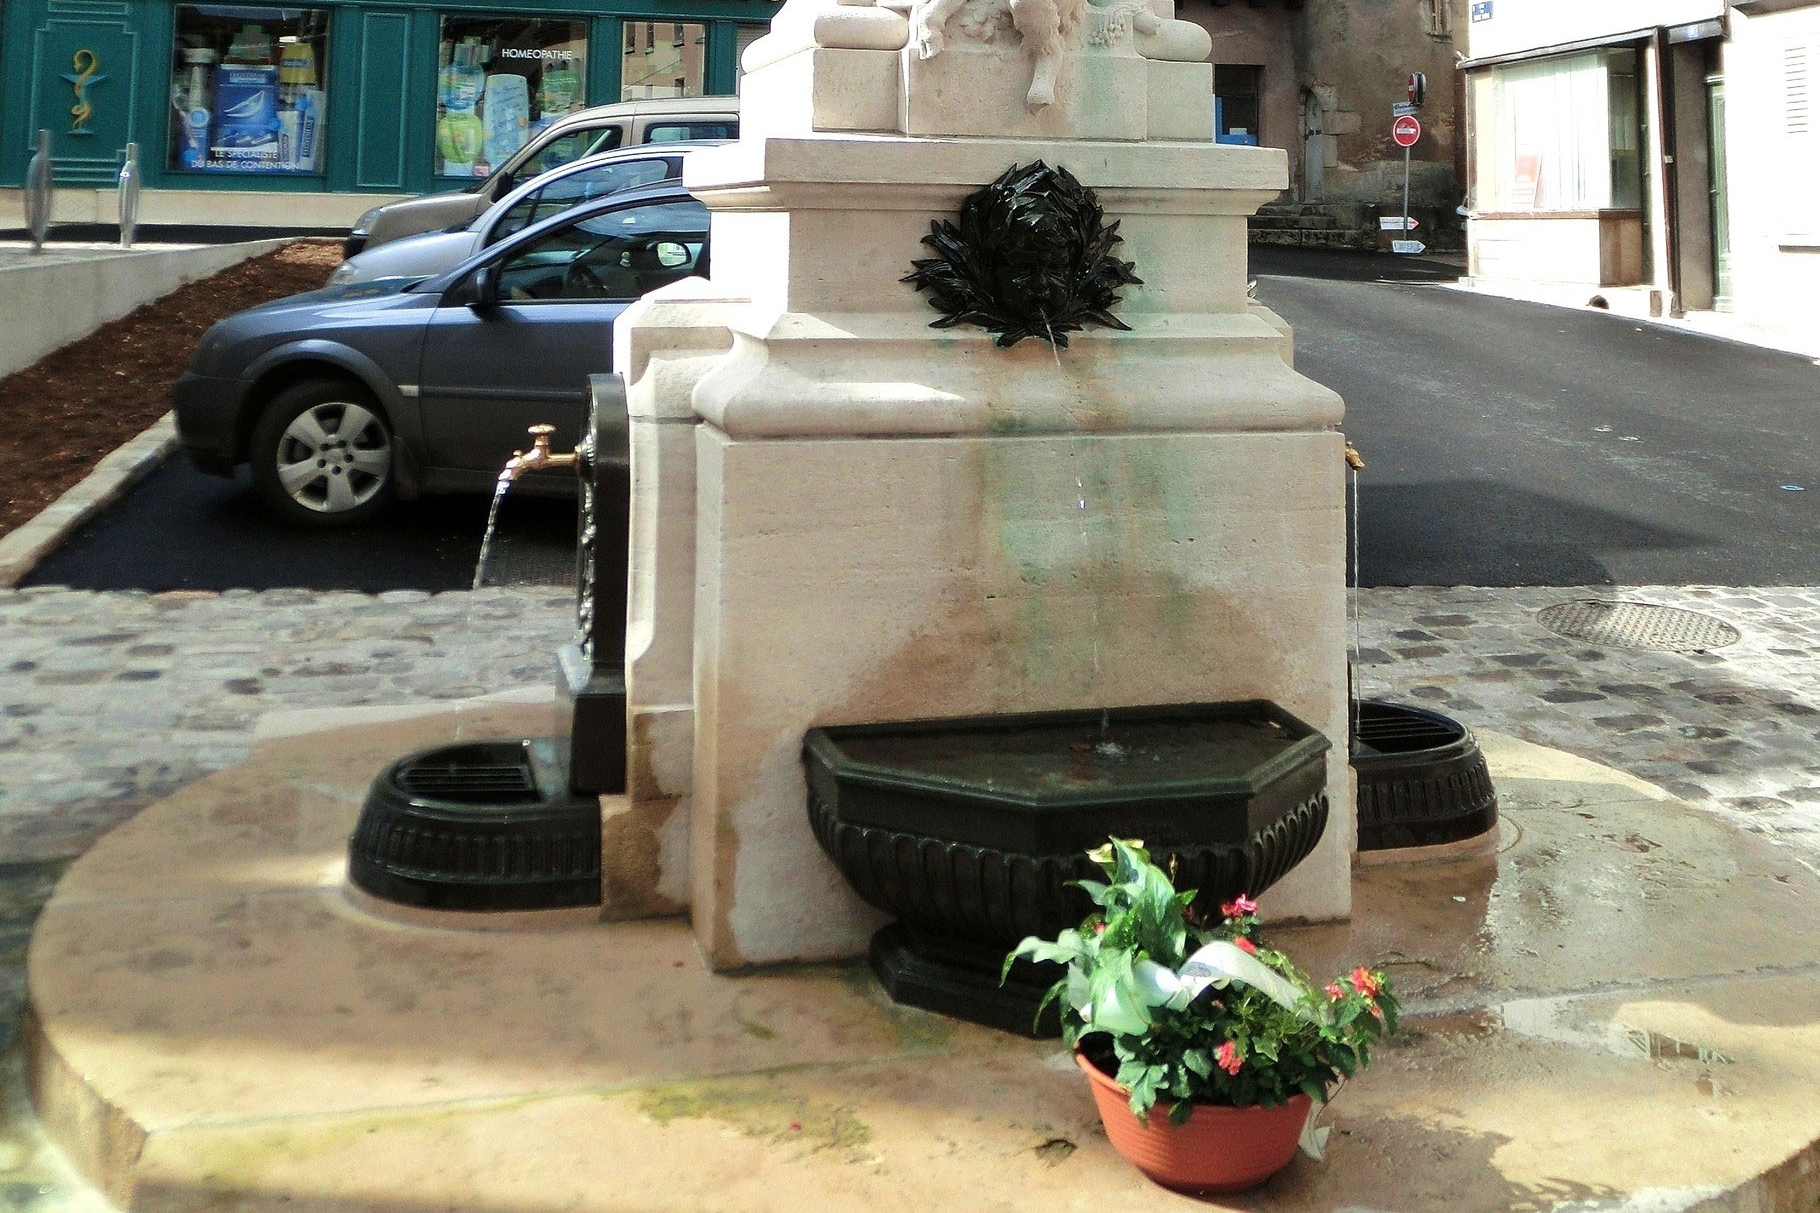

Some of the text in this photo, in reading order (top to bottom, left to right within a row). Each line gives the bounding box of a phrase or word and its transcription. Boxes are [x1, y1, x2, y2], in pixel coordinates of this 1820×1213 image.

[501, 48, 573, 61] HOMEOPATHIE
[215, 150, 278, 159] LE SPECIALISTE
[206, 160, 223, 168] BAS
[226, 160, 237, 168] DE
[240, 160, 299, 170] CONTENTION
